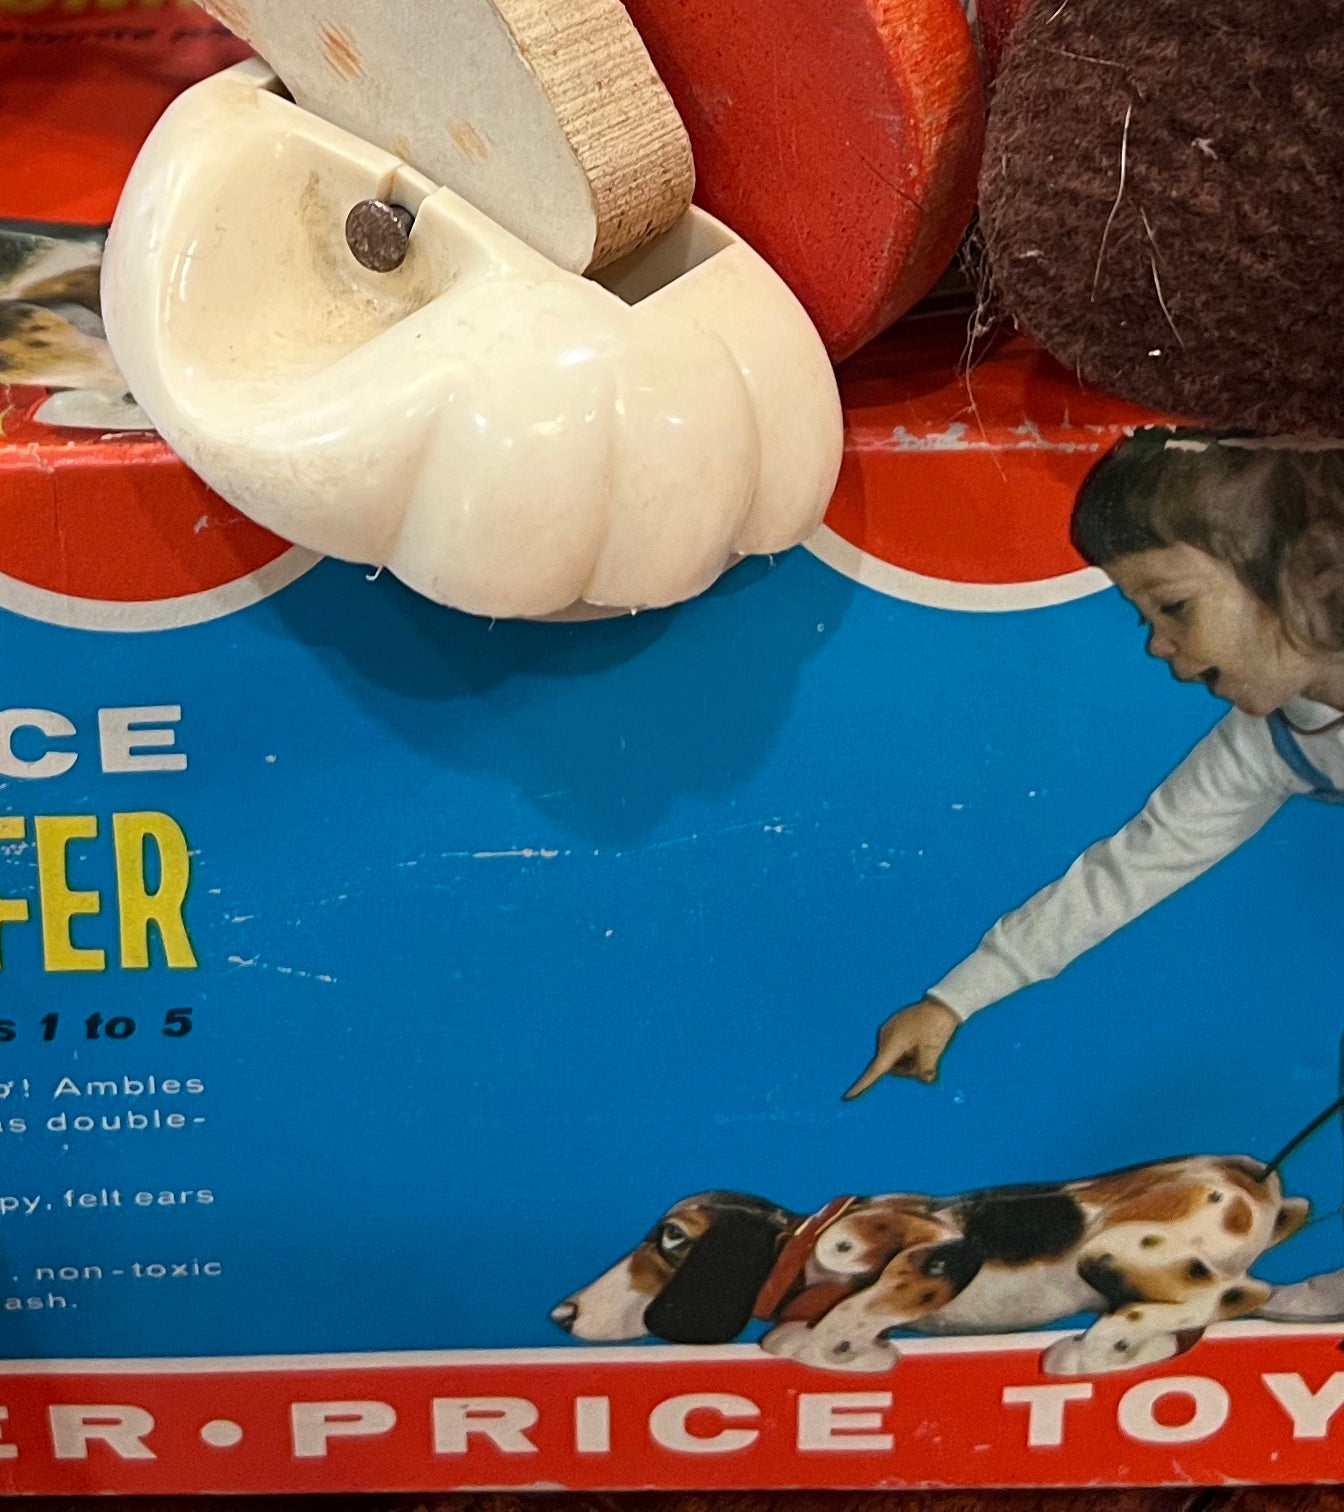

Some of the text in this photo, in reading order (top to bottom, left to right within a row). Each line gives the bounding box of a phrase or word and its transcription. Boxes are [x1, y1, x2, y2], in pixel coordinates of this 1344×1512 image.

[40, 1013, 59, 1041] 1
[85, 1011, 136, 1040] to
[162, 1007, 194, 1038] 5
[53, 1076, 206, 1097] Ambles
[46, 1109, 207, 1131] double-
[63, 1188, 122, 1209] felt
[134, 1187, 216, 1208] ears
[36, 1259, 222, 1283] non-toxic
[289, 1391, 895, 1459] PRICE
